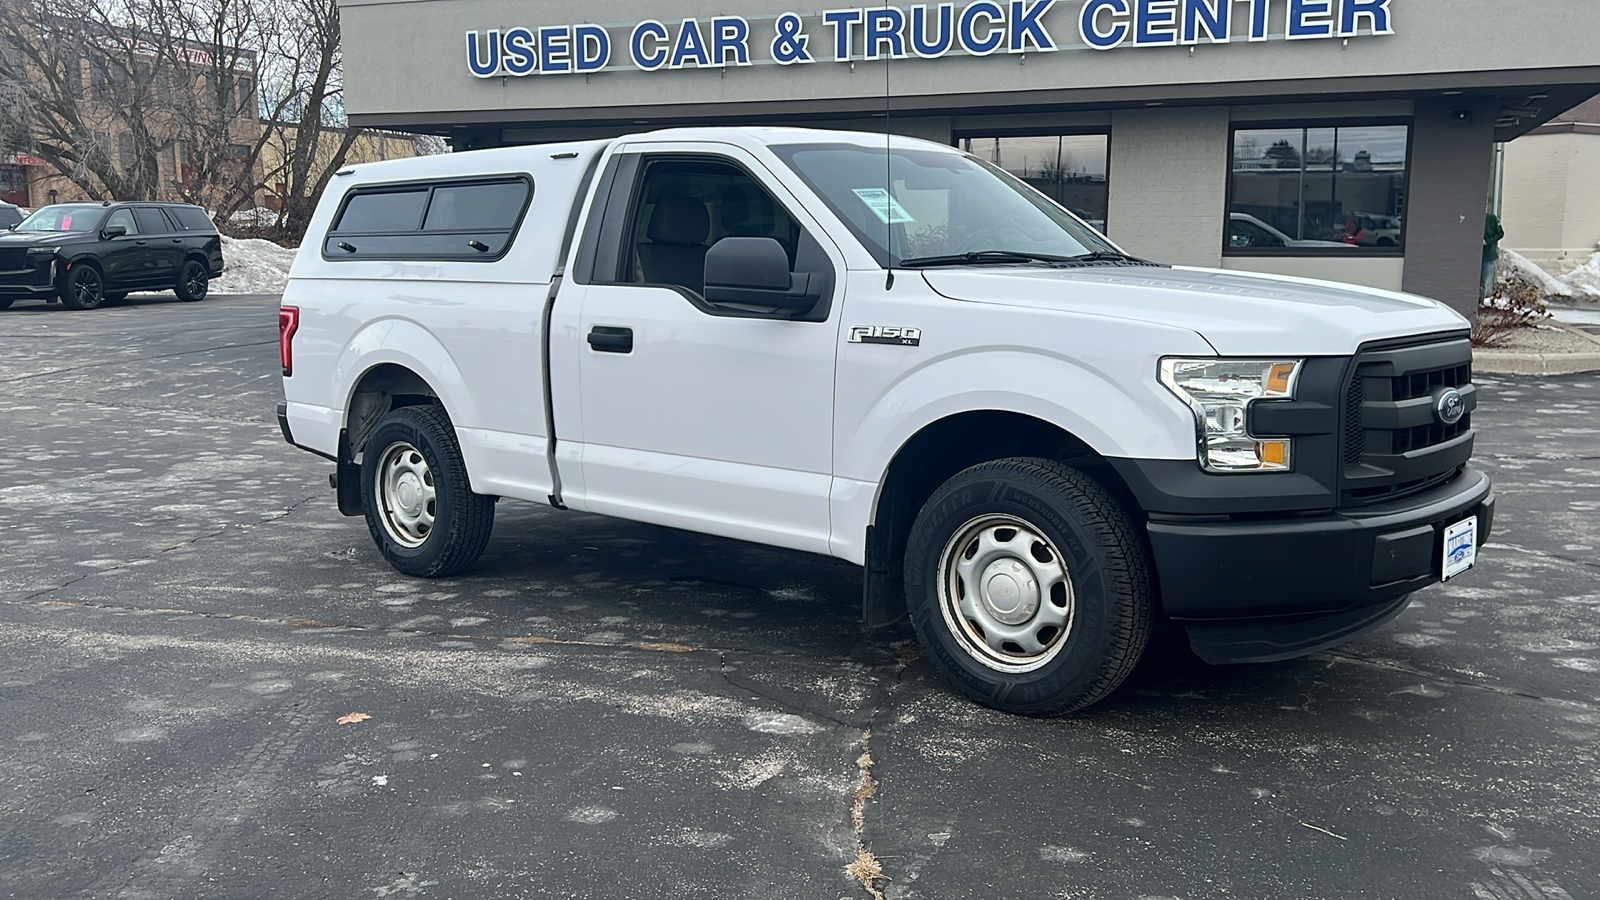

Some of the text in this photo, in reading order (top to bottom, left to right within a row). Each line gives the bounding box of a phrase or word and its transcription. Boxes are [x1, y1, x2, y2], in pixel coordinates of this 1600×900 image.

[466, 0, 1395, 79] USED CAR & TRUCK CENTER
[911, 488, 973, 587] WRANGLER
[1013, 491, 1070, 537] WORKHORSE
